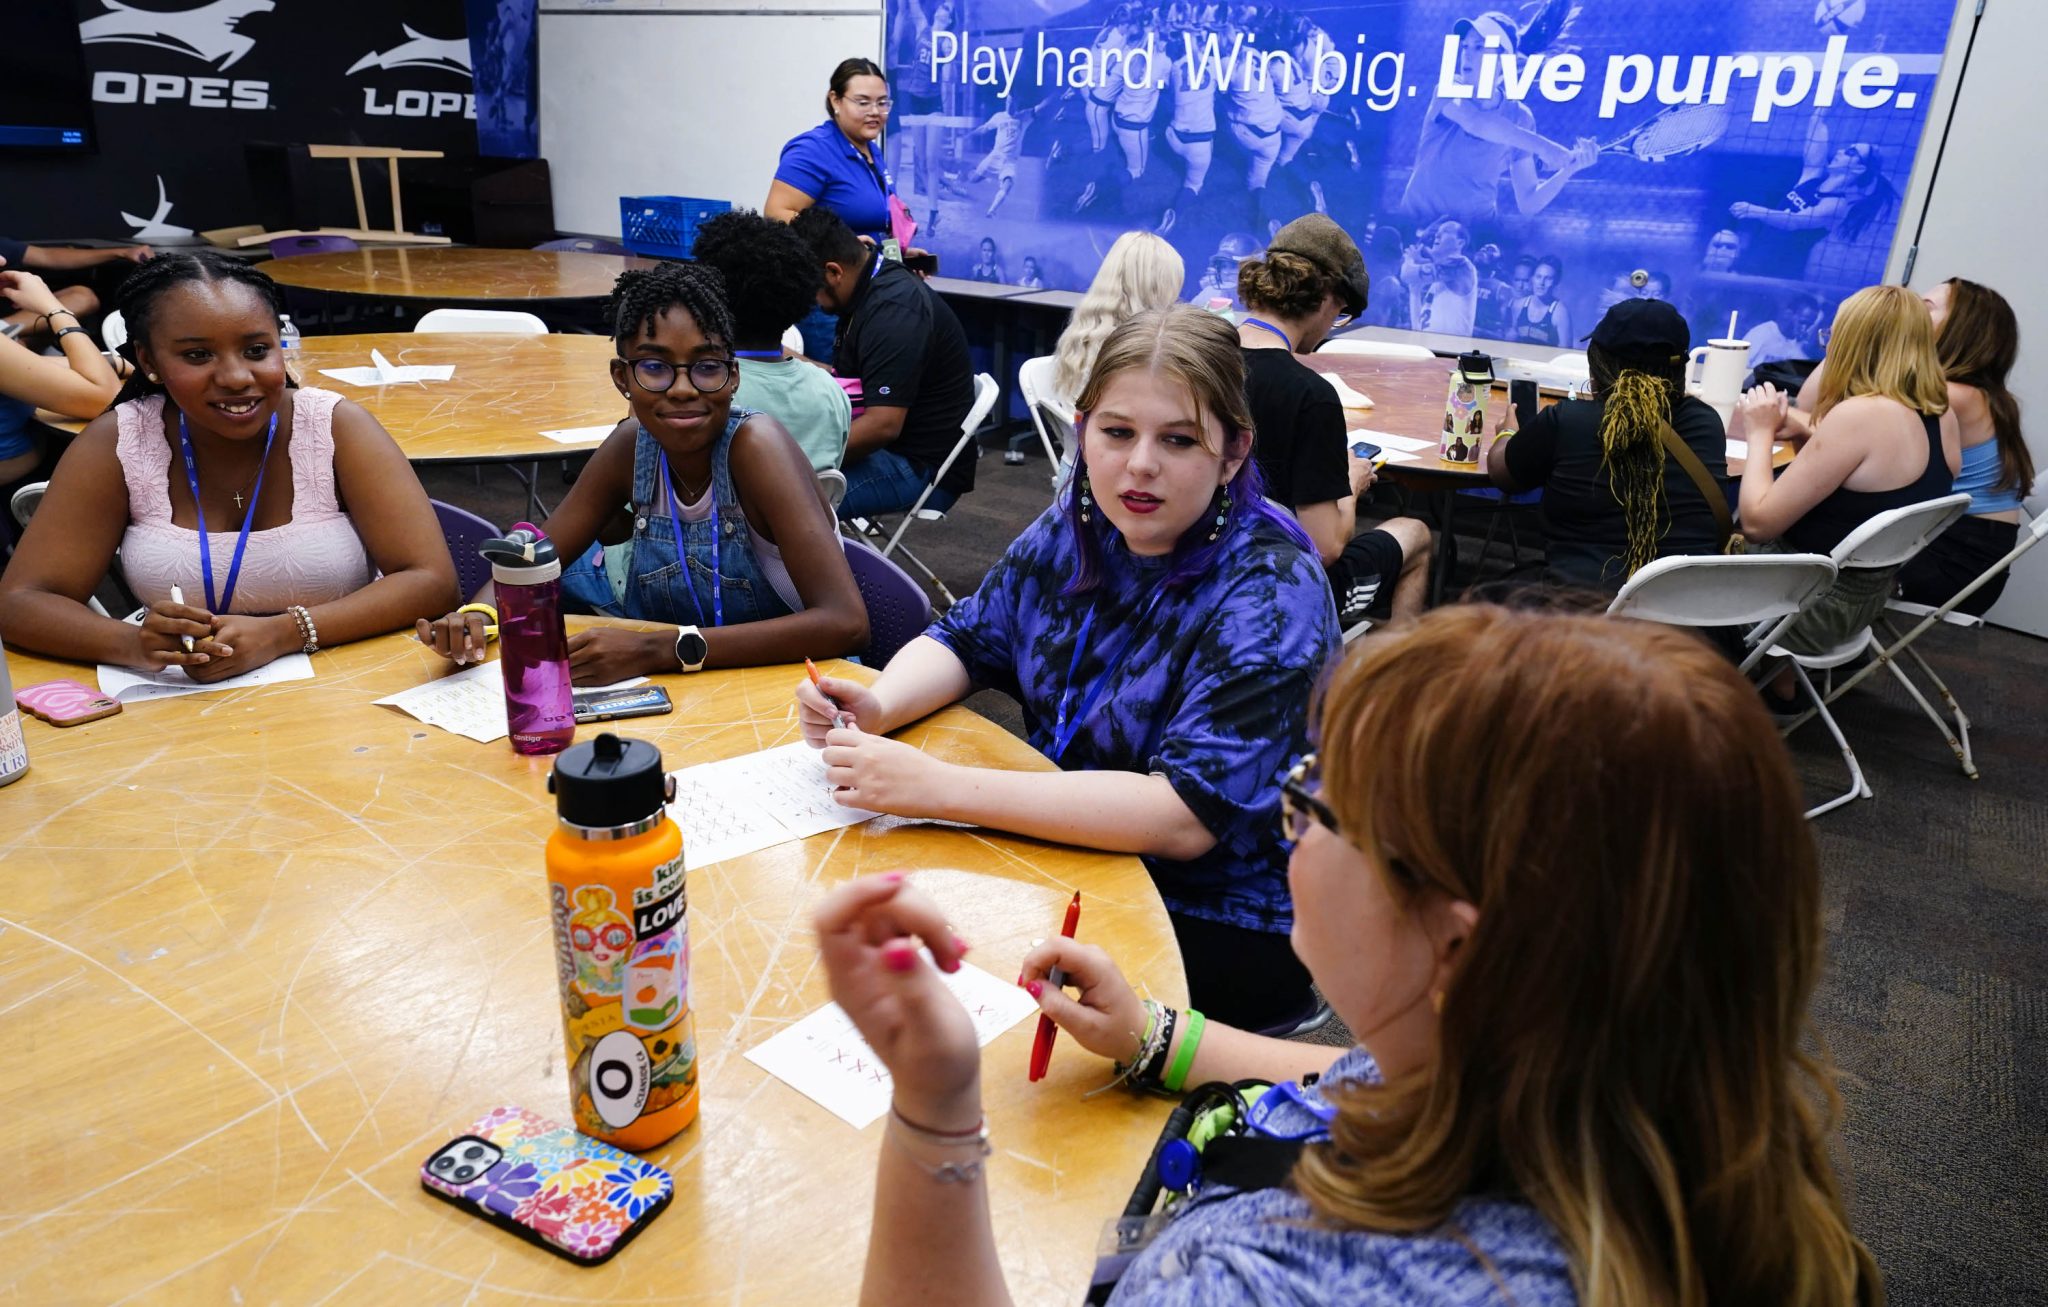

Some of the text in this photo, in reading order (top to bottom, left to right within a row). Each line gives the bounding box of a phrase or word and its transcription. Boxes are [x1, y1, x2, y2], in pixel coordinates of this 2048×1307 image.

[930, 30, 1917, 122] Play hard. Win big. Live purple.
[513, 734, 541, 743] contigo
[636, 889, 653, 904] is
[639, 891, 685, 933] LOVE
[596, 1059, 633, 1099] O
